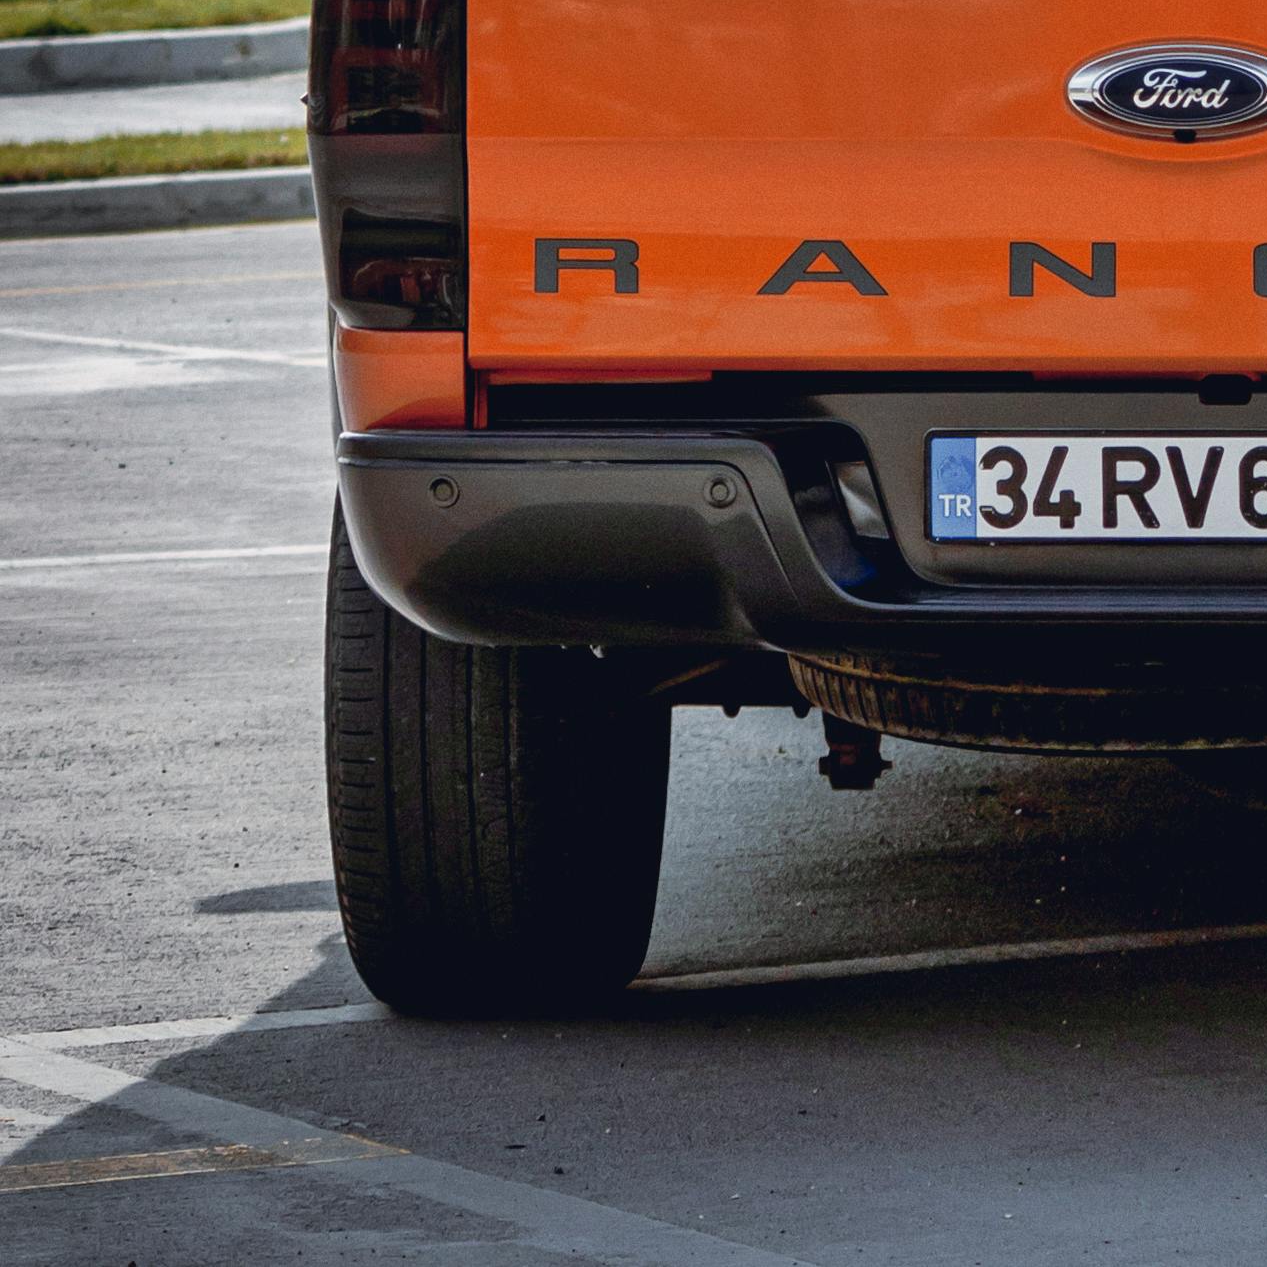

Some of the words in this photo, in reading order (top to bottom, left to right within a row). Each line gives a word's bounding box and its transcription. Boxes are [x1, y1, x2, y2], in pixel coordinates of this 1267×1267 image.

[1132, 67, 1231, 109] Ford
[938, 494, 972, 517] TR
[978, 445, 1082, 530] 34
[1102, 445, 1225, 530] RV
